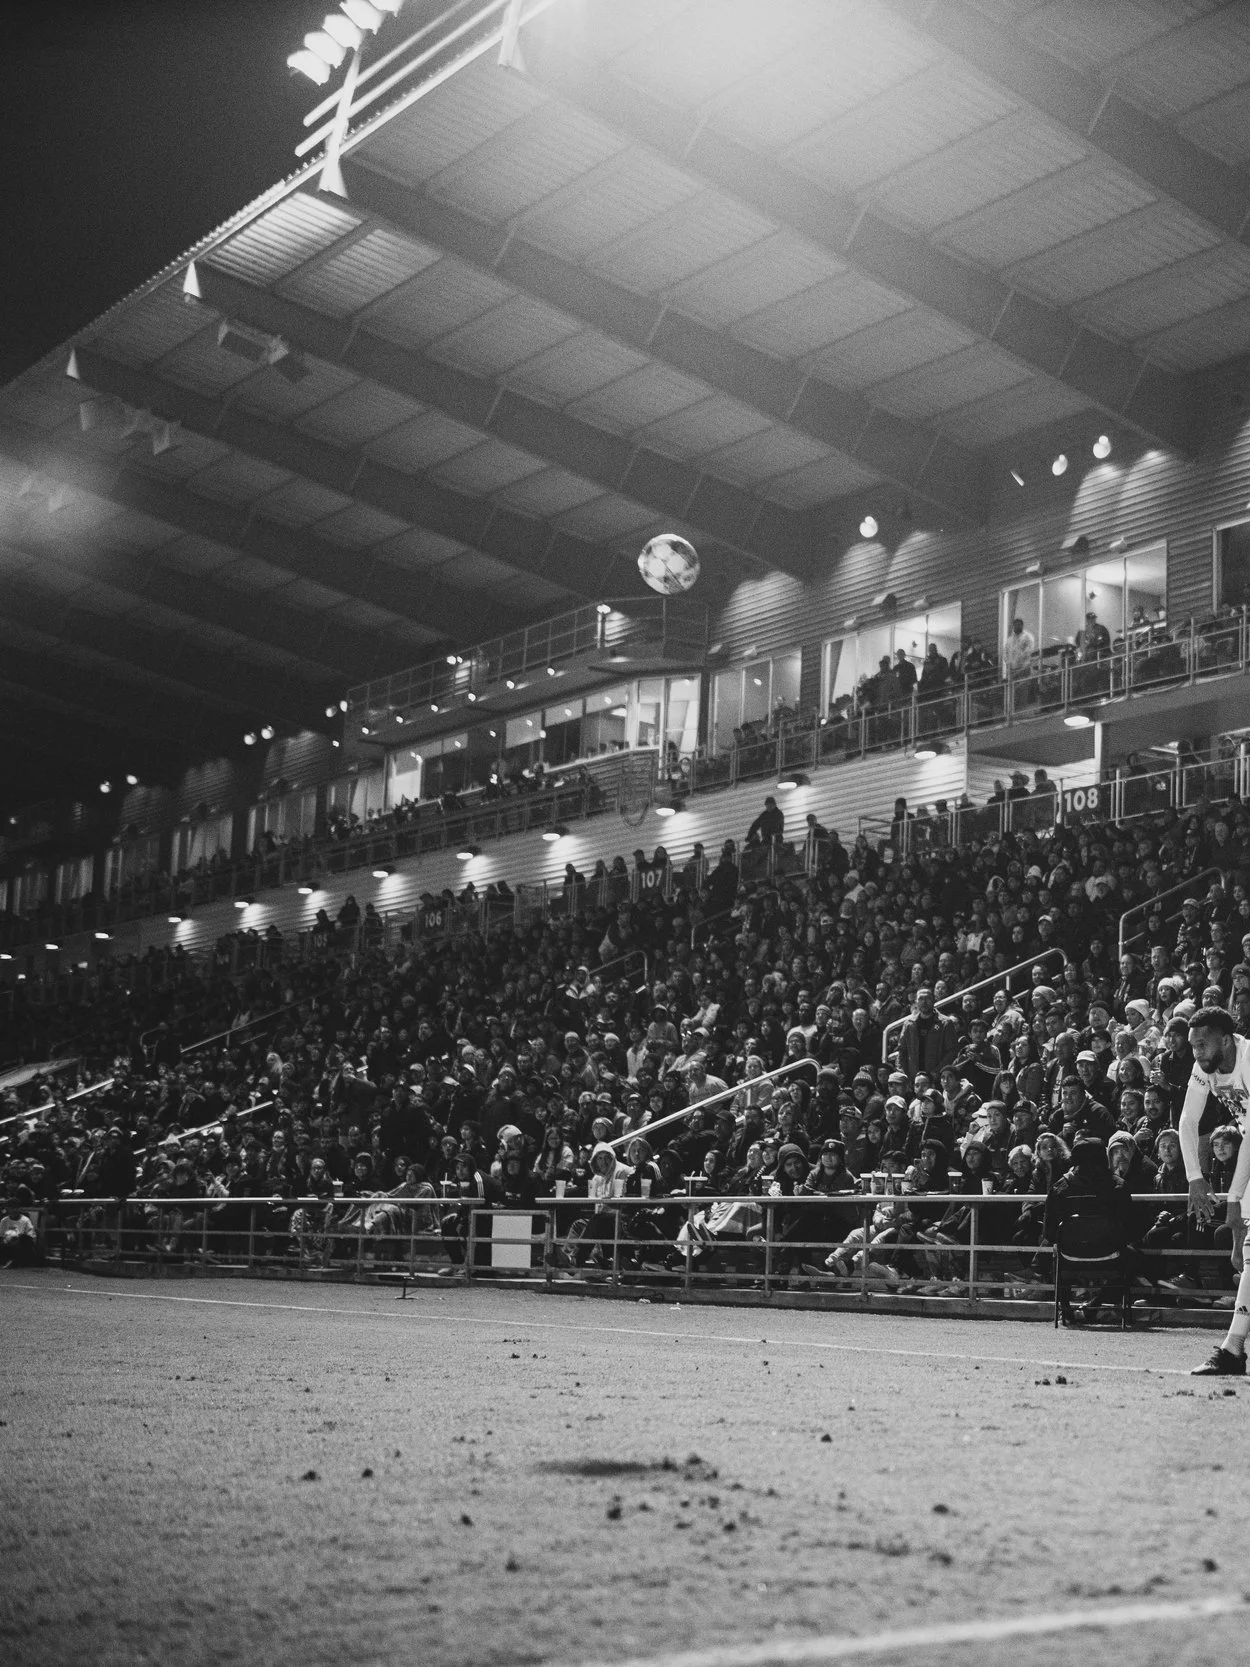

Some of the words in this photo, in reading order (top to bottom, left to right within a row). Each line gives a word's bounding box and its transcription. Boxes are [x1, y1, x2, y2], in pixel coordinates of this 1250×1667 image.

[1064, 787, 1098, 812] 108
[641, 869, 662, 888] 107
[424, 910, 441, 928] 106
